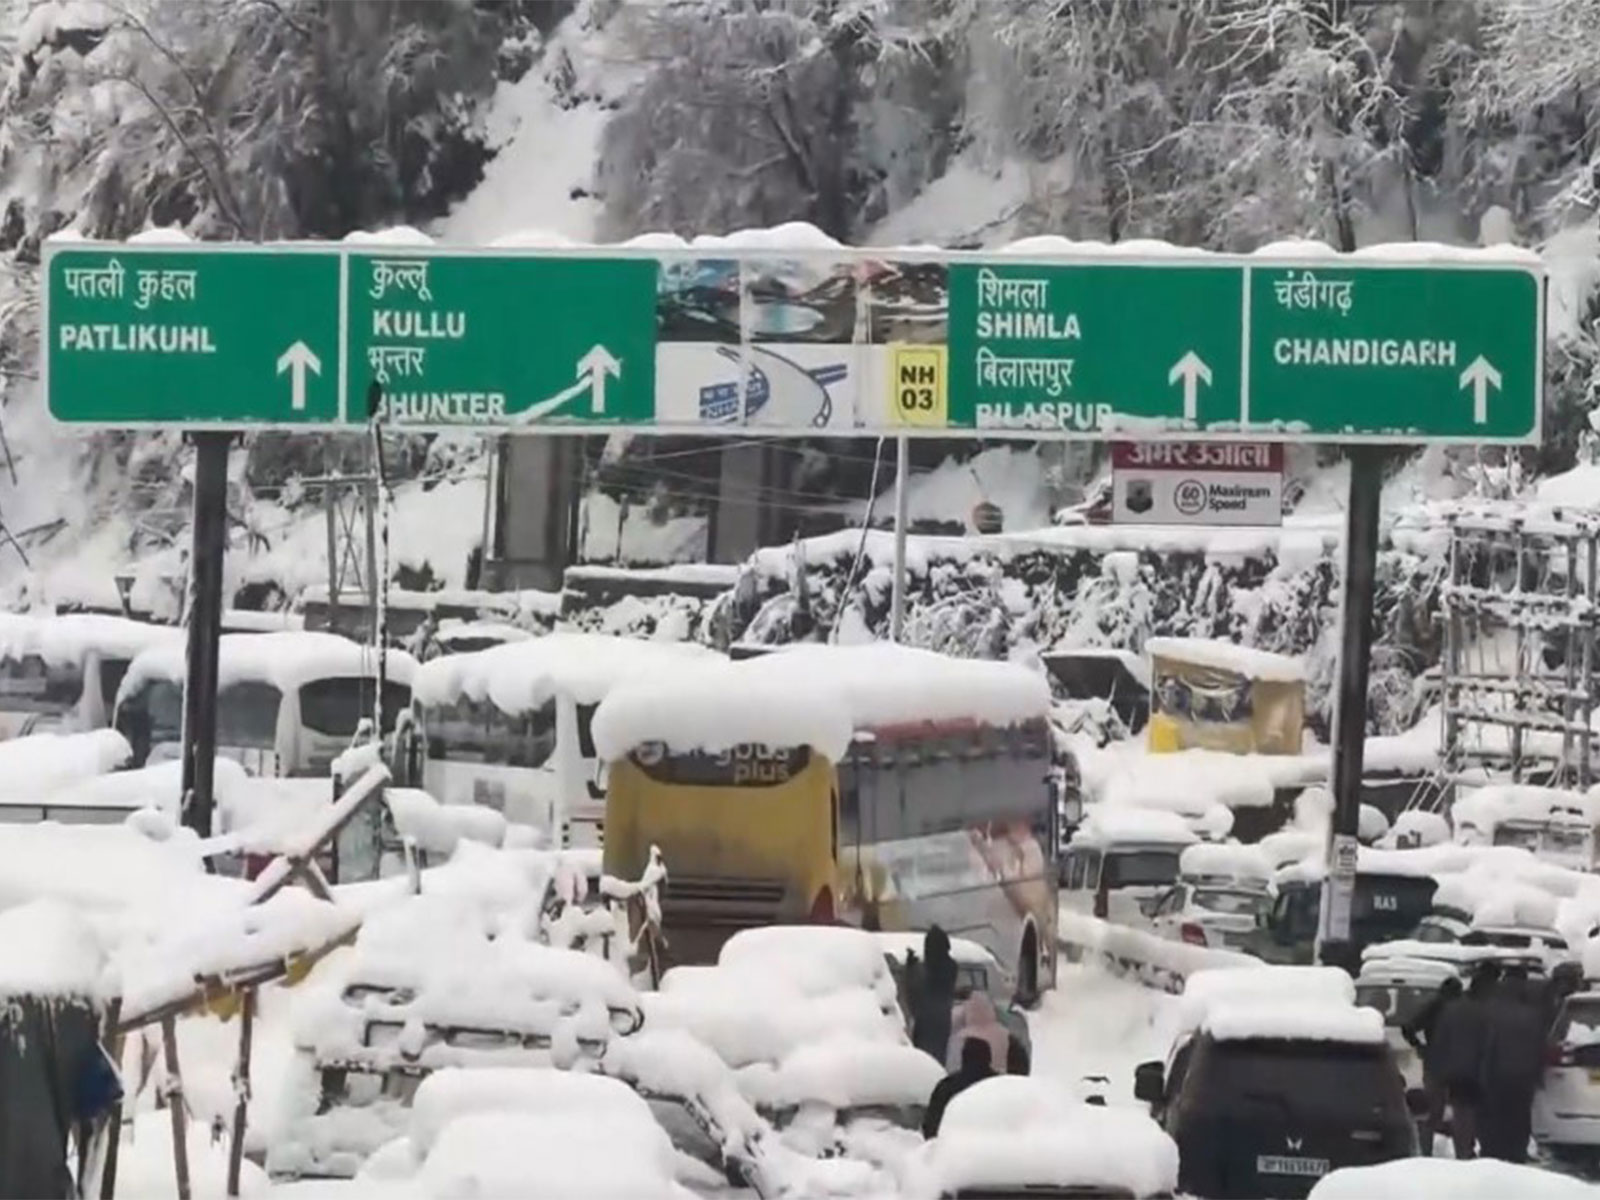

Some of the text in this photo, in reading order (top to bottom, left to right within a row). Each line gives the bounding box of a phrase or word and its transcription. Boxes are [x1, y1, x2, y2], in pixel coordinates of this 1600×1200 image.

[63, 258, 198, 309] पतली कुहल
[369, 260, 432, 301] कुल्लू
[976, 268, 1049, 308] शिमला
[1273, 270, 1354, 316] चंडीगढ़
[372, 310, 465, 338] KULLU
[976, 312, 1081, 340] SHIMLA
[60, 324, 216, 353] PATLIKUHL
[1273, 338, 1457, 367] CHANDIGARH
[900, 365, 935, 384] NH
[976, 346, 1074, 396] बिलासपुर
[901, 388, 934, 410] 03
[1208, 483, 1271, 498] Maximum
[1208, 498, 1247, 513] Speed
[734, 760, 790, 784] plus
